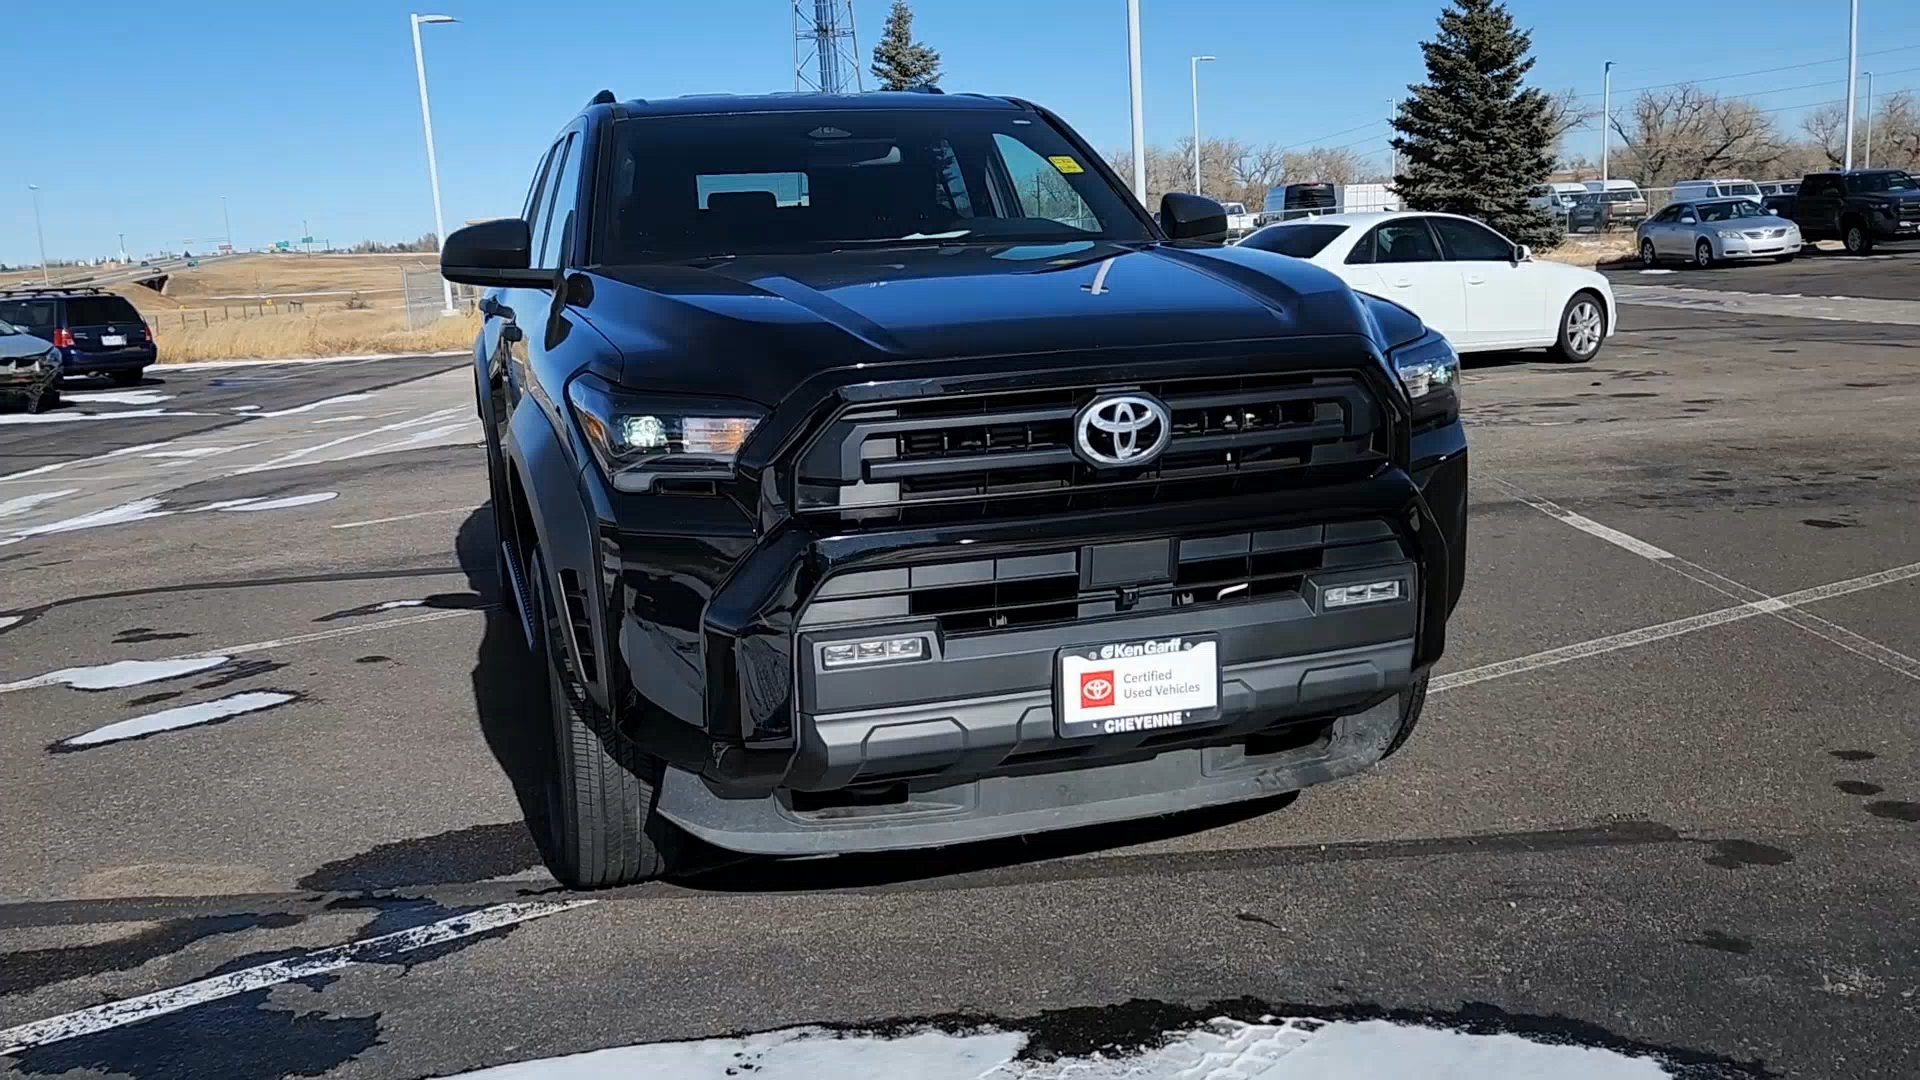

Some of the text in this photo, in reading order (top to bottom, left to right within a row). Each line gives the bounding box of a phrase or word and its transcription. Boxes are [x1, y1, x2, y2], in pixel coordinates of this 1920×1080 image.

[1123, 669, 1172, 683] Certified
[1124, 682, 1200, 699] Used Vehicles
[1104, 712, 1182, 733] CHEYENNE
